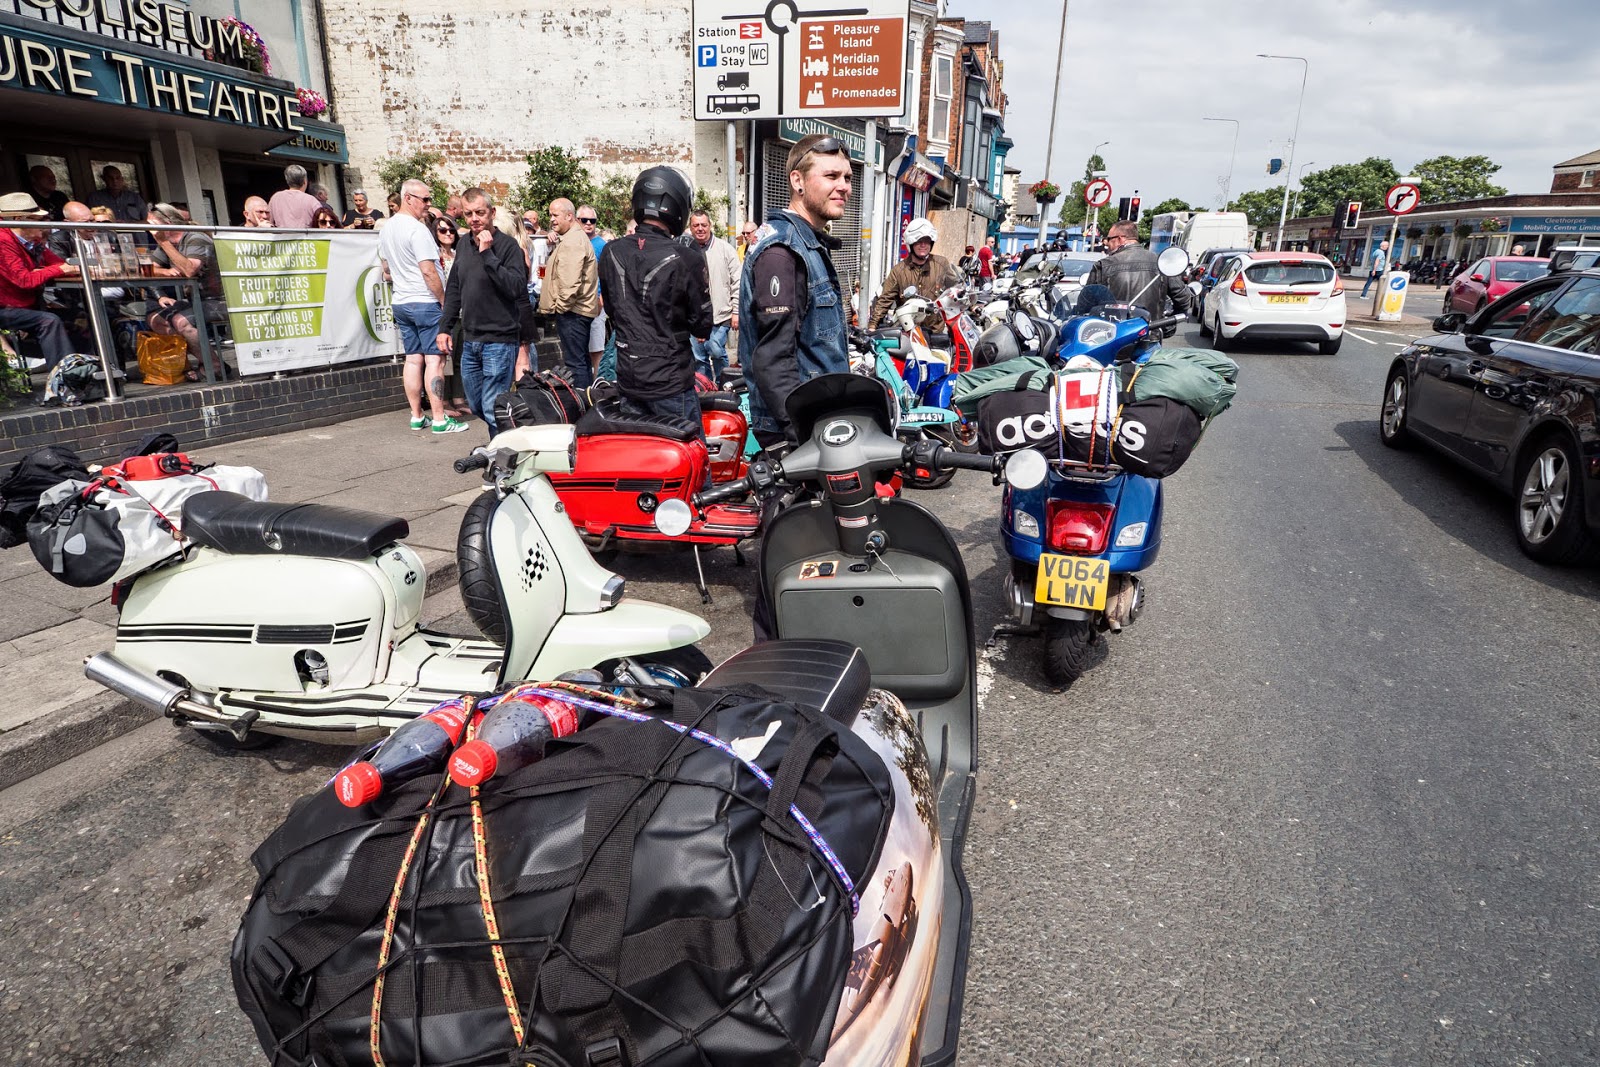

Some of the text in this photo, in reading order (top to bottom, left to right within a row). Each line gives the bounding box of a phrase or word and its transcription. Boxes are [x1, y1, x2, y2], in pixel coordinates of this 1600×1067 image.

[24, 0, 244, 59] LISEUM
[698, 27, 737, 38] Station
[833, 24, 880, 35] Pleasure
[840, 37, 873, 48] Island
[702, 44, 766, 65] P Long WC
[721, 56, 745, 67] Stay
[832, 53, 880, 64] Meridian
[832, 65, 879, 77] Lakeside
[111, 53, 304, 132] THEATRE
[831, 87, 897, 98] Promenades
[305, 134, 340, 153] HOUSE
[832, 129, 865, 153] FISHERIE
[1523, 224, 1551, 232] Mobility
[234, 242, 317, 256] AWARD WINNERS
[236, 255, 317, 269] AND EXCLUSIVES
[238, 276, 310, 291] FRUIT CIDERS
[241, 289, 309, 305] AND PERRIES
[245, 310, 314, 327] FEATURING UP
[247, 323, 314, 340] TO 20 CIDERS
[1065, 379, 1099, 410] L
[920, 412, 943, 422] 443V
[1043, 556, 1106, 584] VO64
[1046, 580, 1096, 607] LWN
